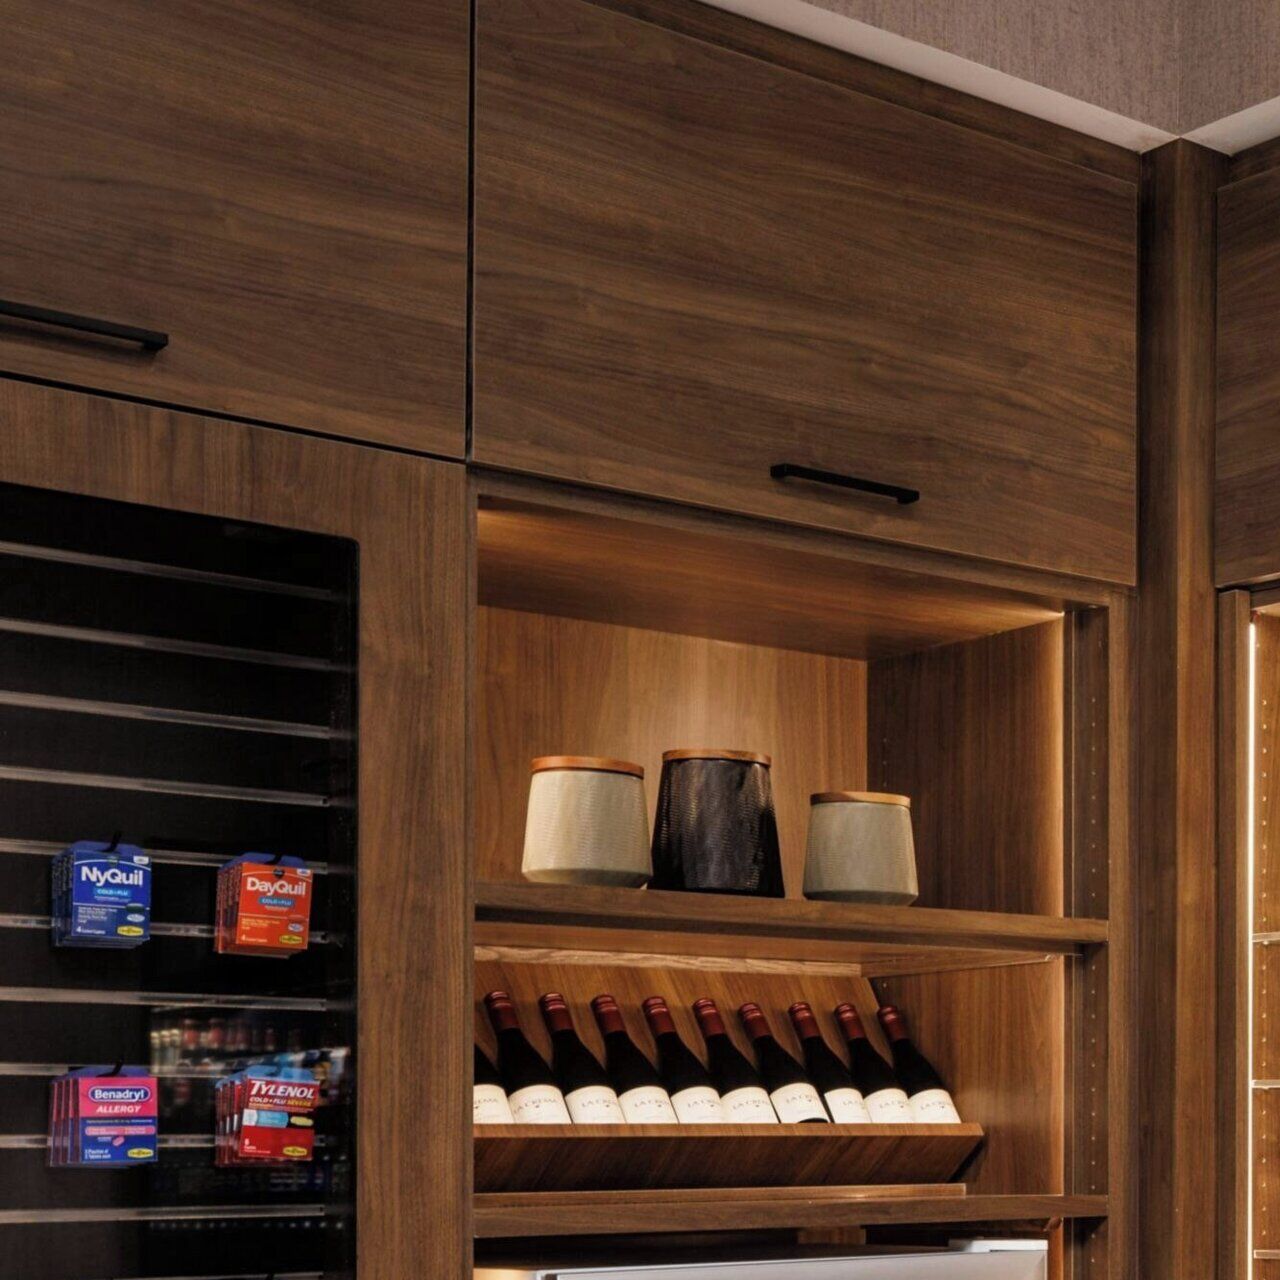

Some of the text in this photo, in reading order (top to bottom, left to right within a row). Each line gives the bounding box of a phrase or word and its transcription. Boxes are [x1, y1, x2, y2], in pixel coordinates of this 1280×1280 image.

[81, 866, 143, 887] NyQuil
[247, 877, 305, 896] DayQuil
[94, 1089, 144, 1102] Benadryl
[250, 1081, 314, 1099] TYLENOL
[96, 1105, 141, 1113] ALLERGY
